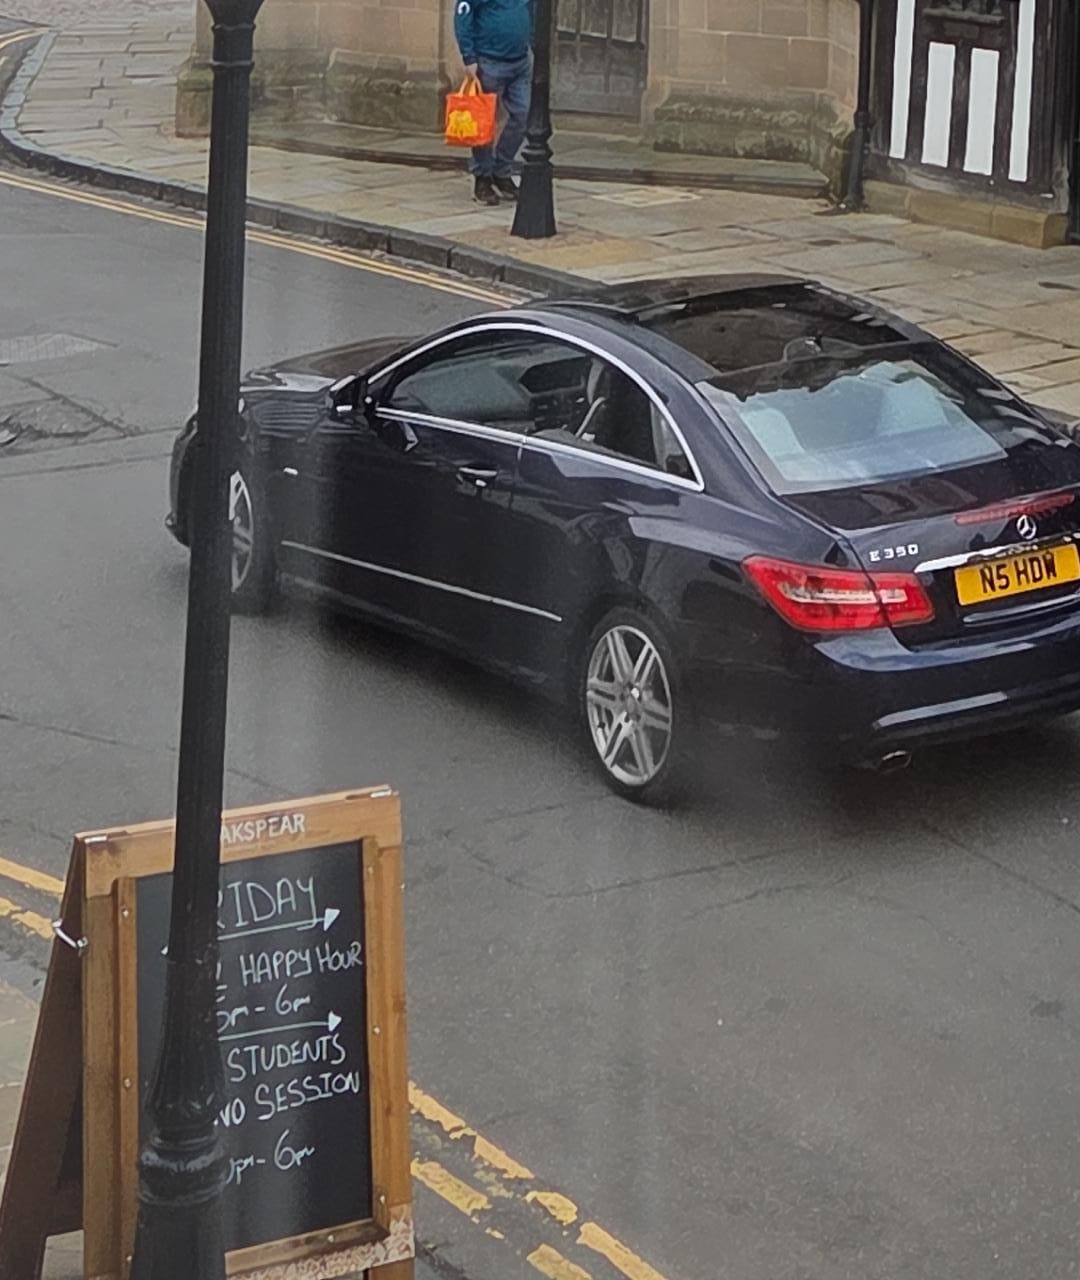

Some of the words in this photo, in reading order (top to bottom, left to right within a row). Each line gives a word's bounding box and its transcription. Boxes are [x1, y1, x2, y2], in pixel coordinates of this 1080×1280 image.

[980, 565, 1010, 593] N5
[1014, 553, 1057, 586] HDW
[220, 813, 306, 844] AKSPEAR
[240, 949, 313, 987] HAPPY
[316, 941, 362, 973] HOUR
[227, 1033, 346, 1082] STUDENTS
[255, 1071, 360, 1120] SESSION
